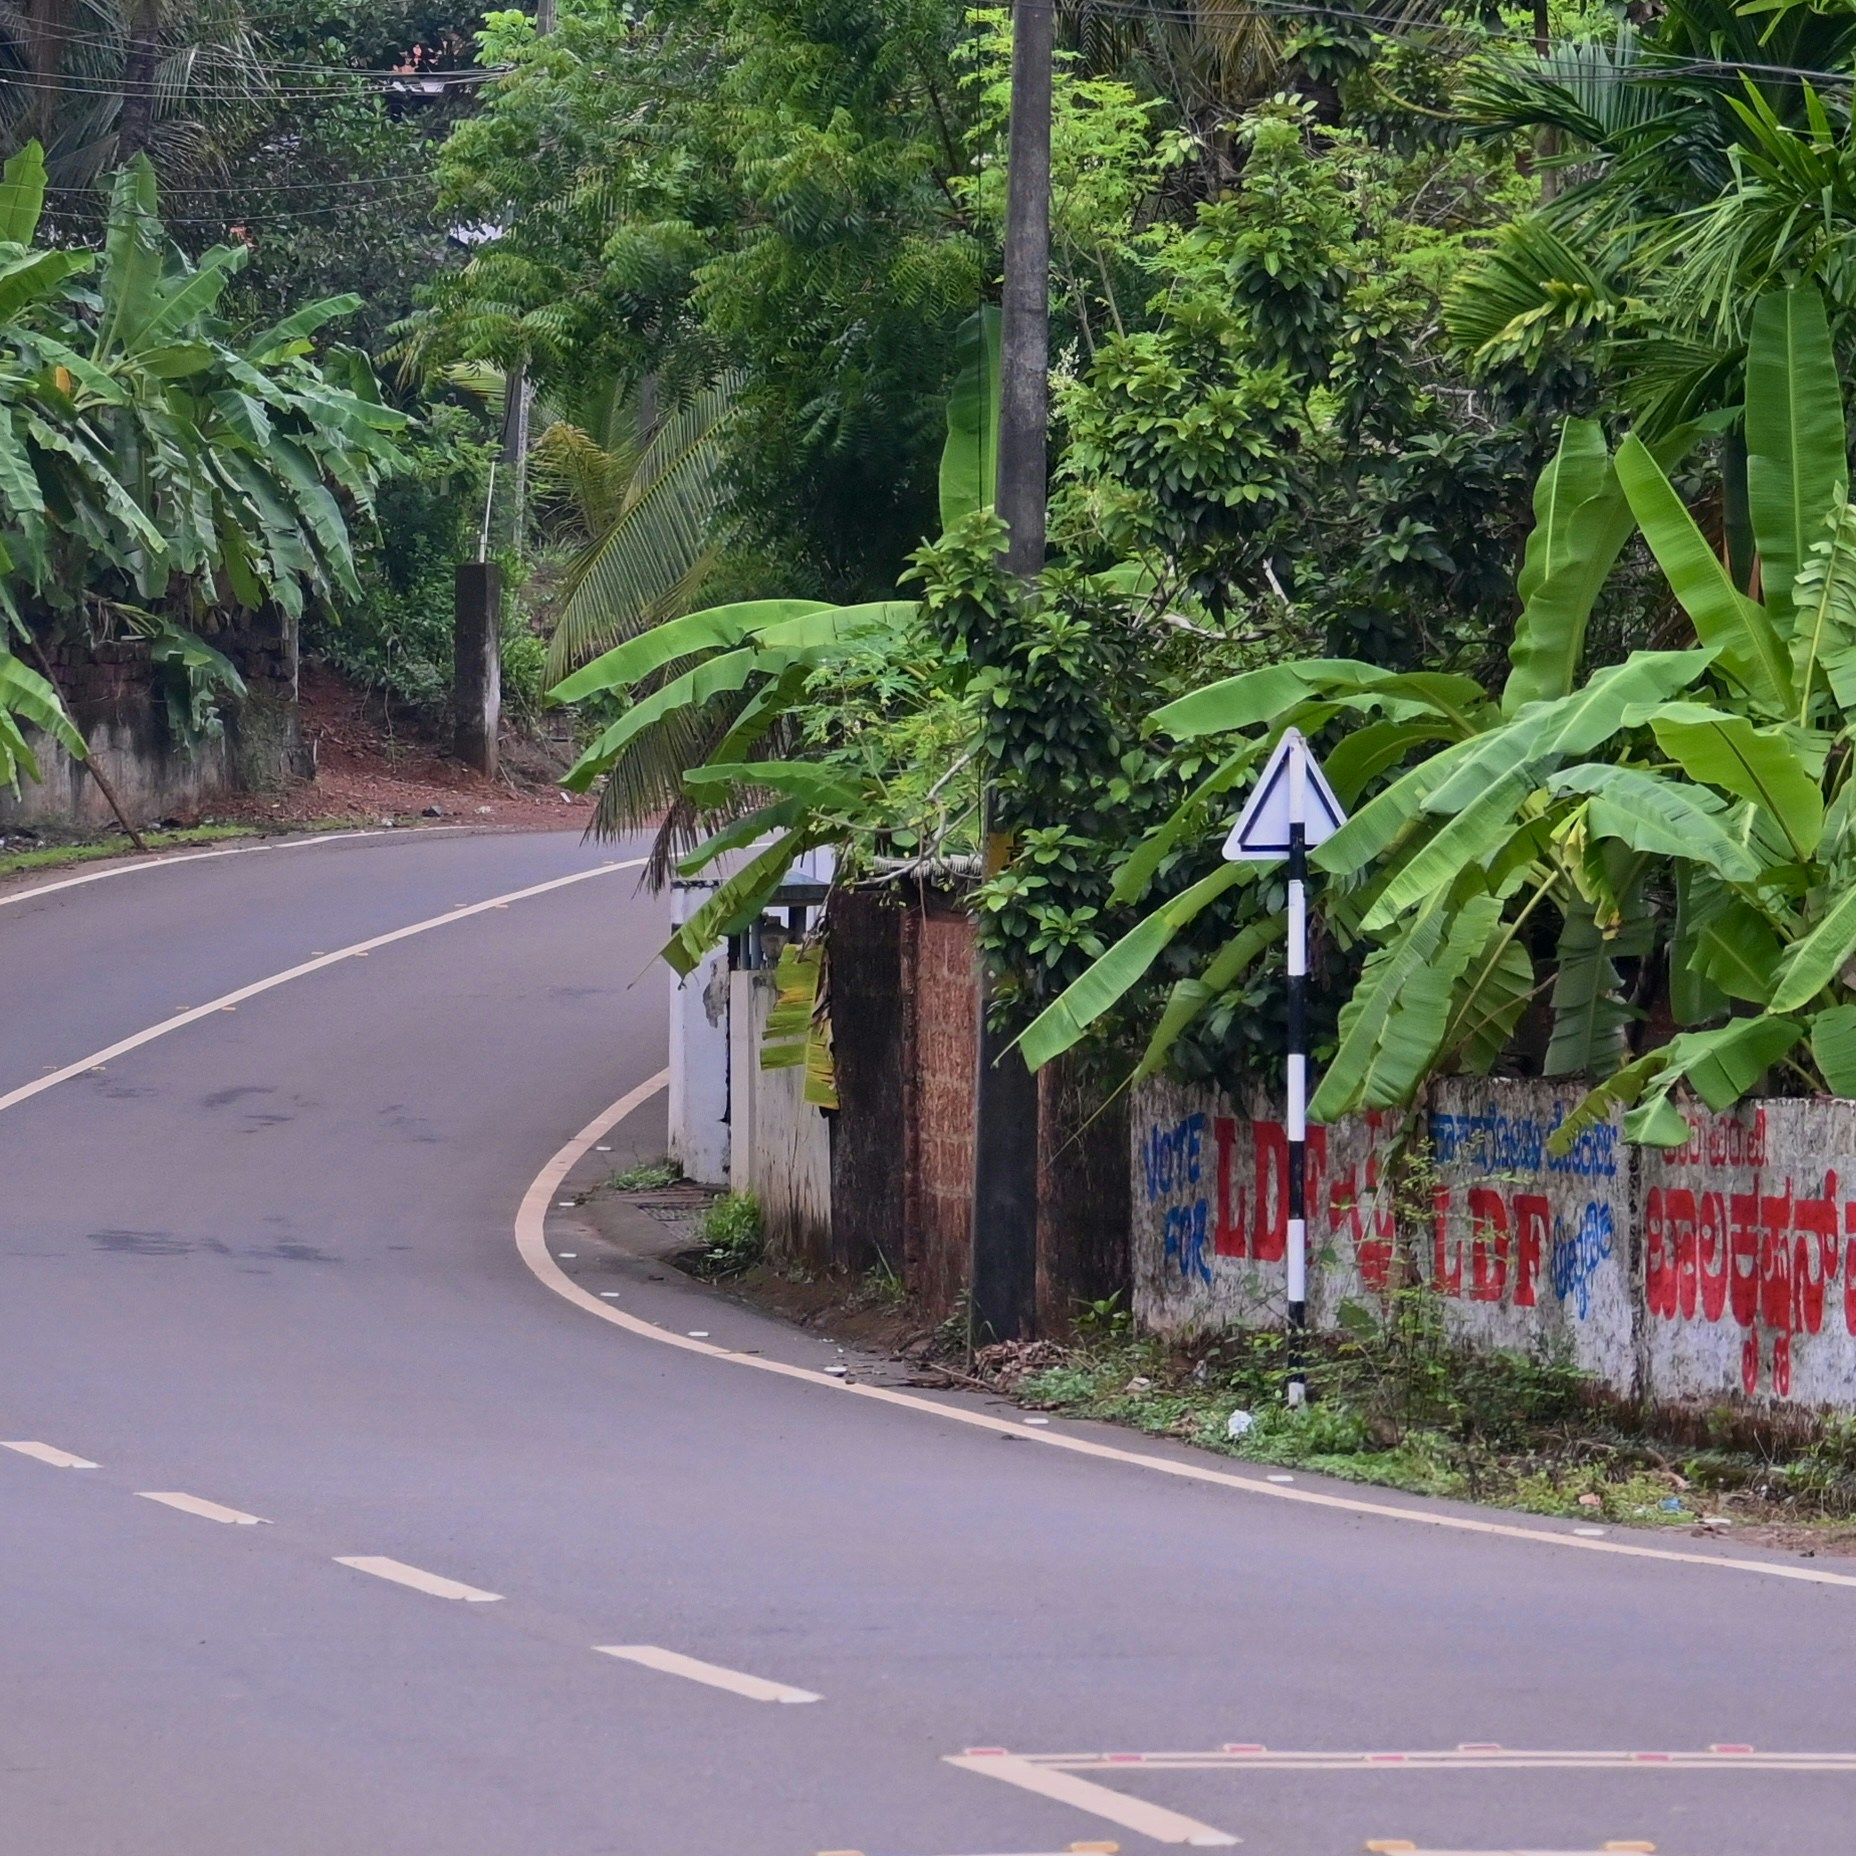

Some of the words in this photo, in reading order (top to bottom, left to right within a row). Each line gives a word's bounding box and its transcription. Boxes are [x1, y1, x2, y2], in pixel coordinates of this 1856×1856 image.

[1143, 1112, 1207, 1201] VOTE
[1164, 1198, 1212, 1288] FOR
[1432, 1185, 1550, 1307] LDF
